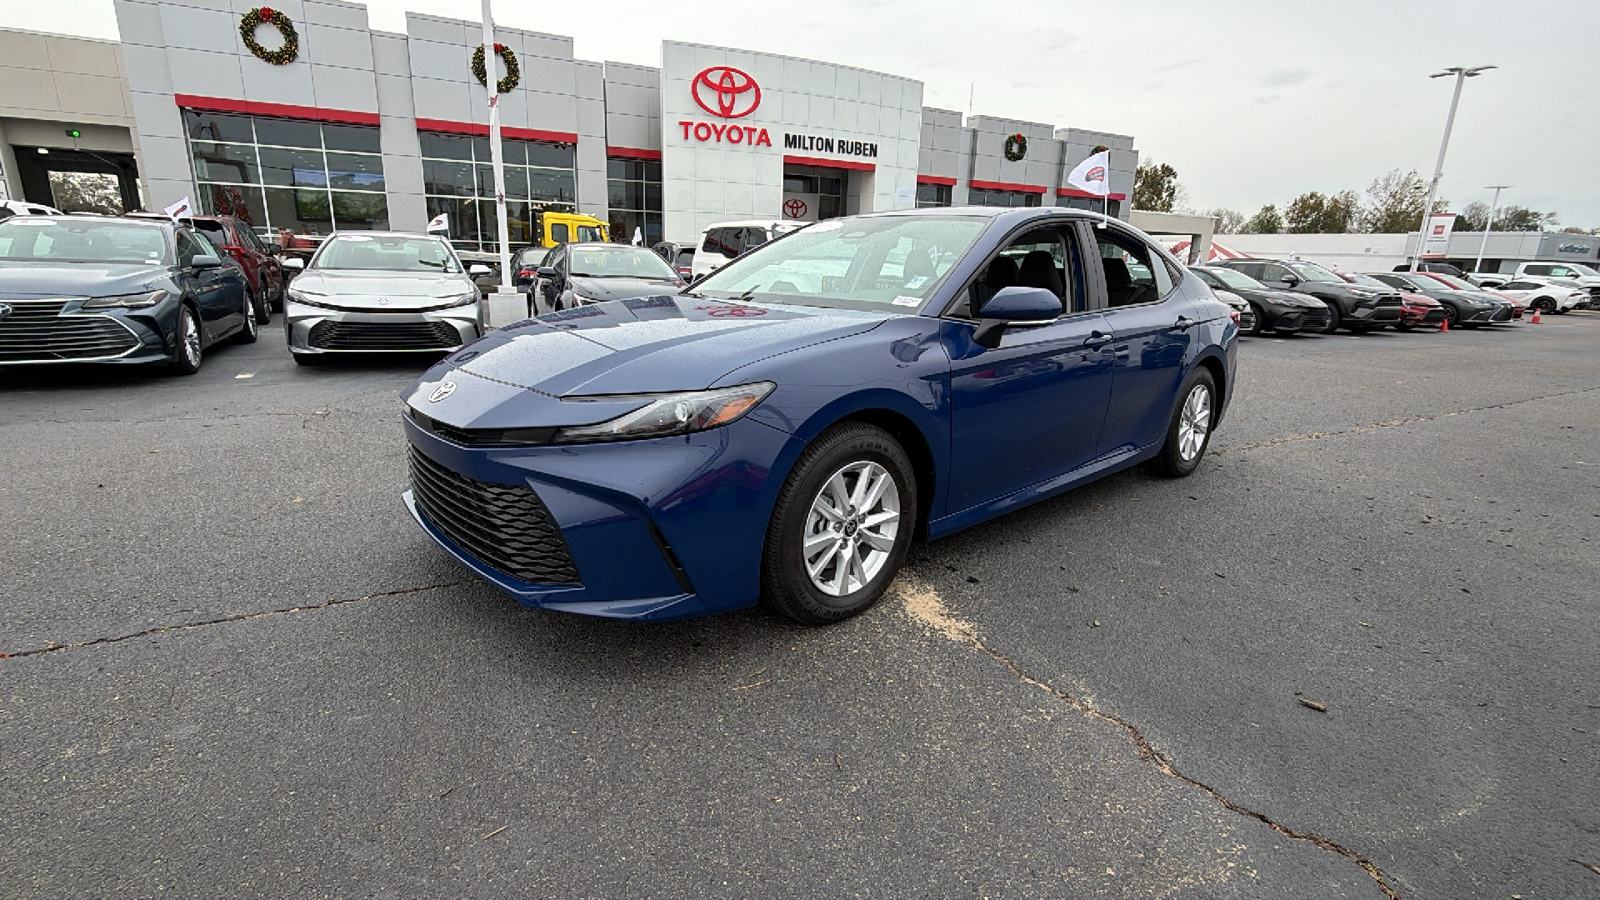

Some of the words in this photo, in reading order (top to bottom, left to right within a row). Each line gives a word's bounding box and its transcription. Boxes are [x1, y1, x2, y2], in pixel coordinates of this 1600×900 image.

[679, 121, 772, 147] TOYOTA
[784, 133, 834, 153] MILTON
[837, 139, 878, 158] RUBEN
